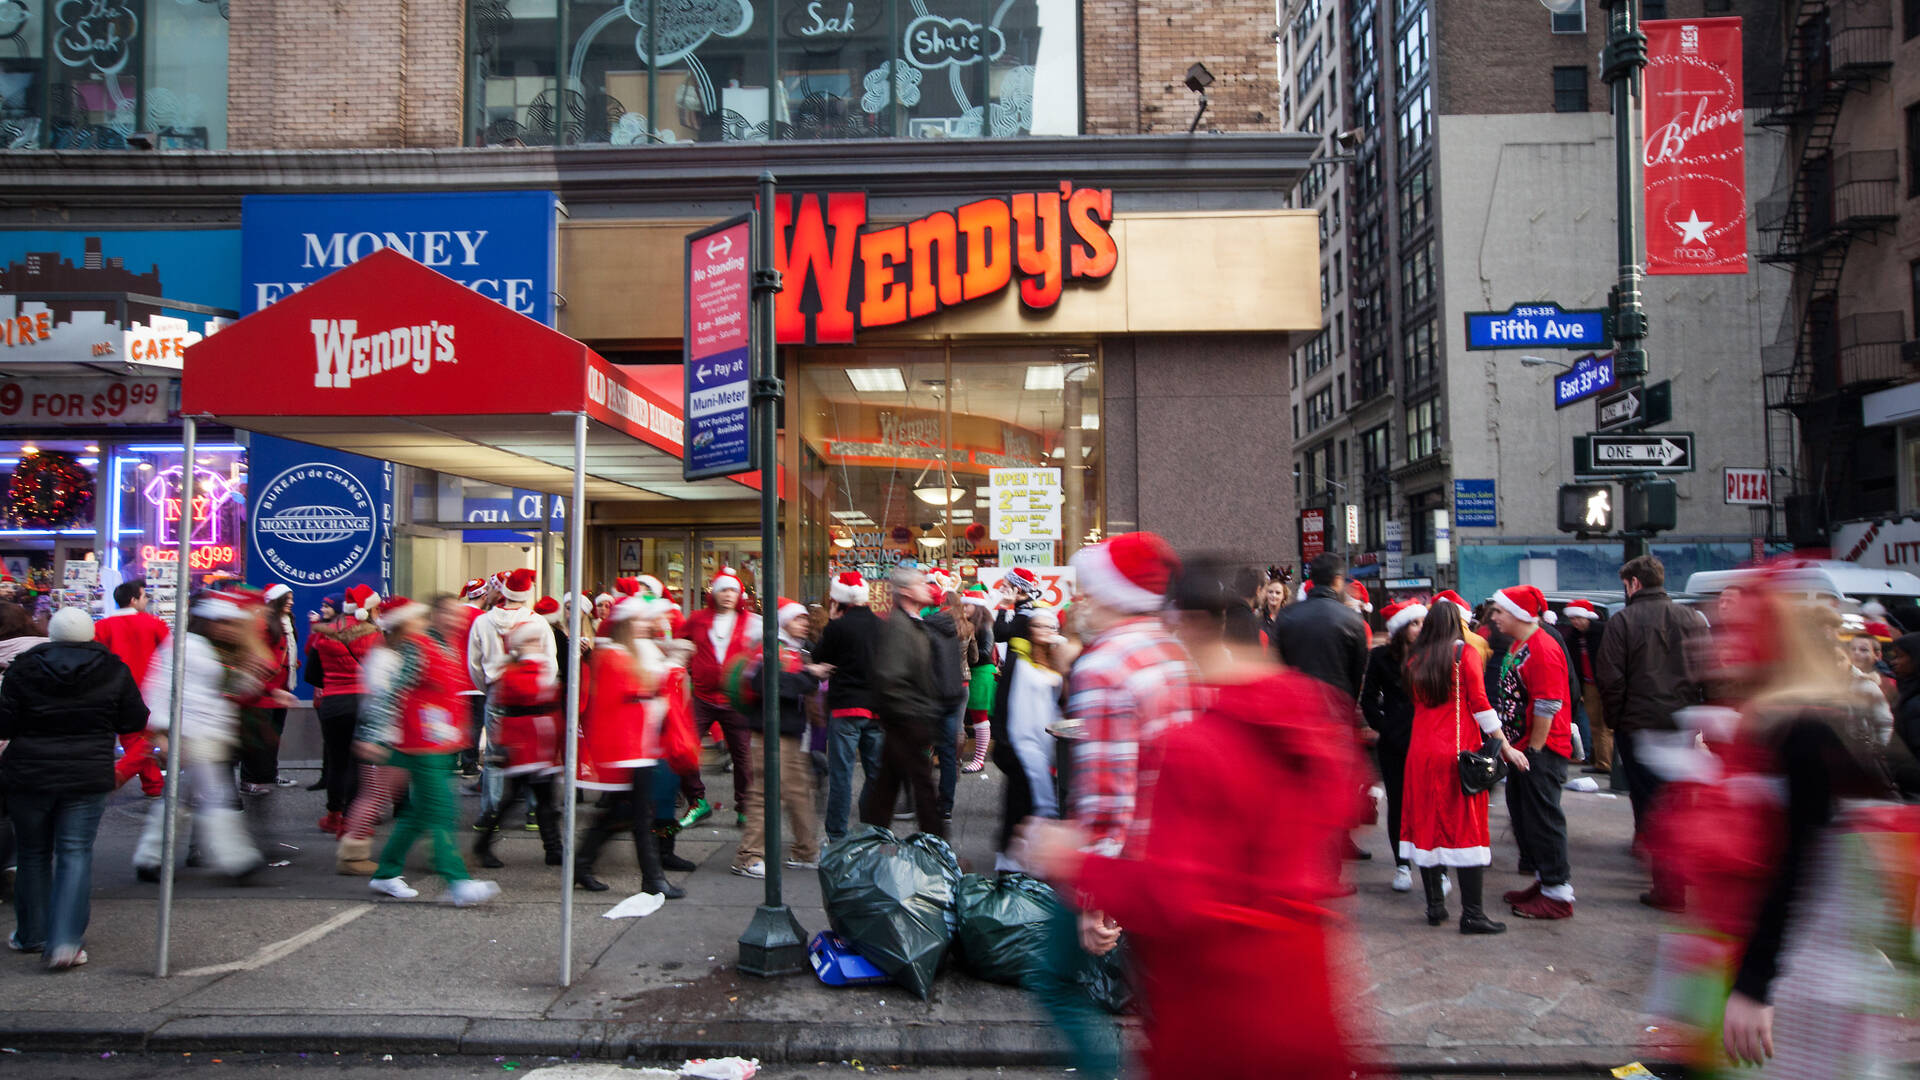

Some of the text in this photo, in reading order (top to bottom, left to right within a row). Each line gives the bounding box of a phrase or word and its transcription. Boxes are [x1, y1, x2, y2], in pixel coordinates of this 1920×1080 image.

[801, 2, 857, 36] Sak
[915, 27, 981, 54] Share
[1643, 95, 1744, 167] Believe
[302, 230, 489, 269] MONEY
[694, 256, 745, 282] No Standing
[1490, 319, 1584, 340] Fifth Ave
[131, 337, 184, 360] CAFE
[310, 319, 456, 388] Wendy's
[714, 359, 743, 377] Pay at
[588, 365, 606, 405] OLD
[1561, 378, 1580, 399] East
[1599, 365, 1610, 385] St
[33, 394, 84, 416] FOR
[693, 390, 746, 411] Muni-Meter
[1604, 399, 1636, 420] ONE WAY
[698, 420, 711, 428] NYC
[717, 423, 744, 434] Available
[1607, 446, 1673, 458] ONE WAY
[263, 469, 367, 510] BUREAU de CHANGE
[994, 472, 1028, 486] OPEN
[1727, 473, 1769, 500] PIZZA
[260, 519, 370, 530] MONEY EXCHANGE
[852, 533, 886, 547] NOW
[1001, 543, 1051, 551] HOT SPOT
[266, 545, 364, 580] BUREAU de CHANGE
[381, 503, 392, 601] EXCHA
[837, 549, 901, 564] COOKING
[1013, 554, 1040, 564] Wi-Fi
[1884, 541, 1920, 566] LITT
